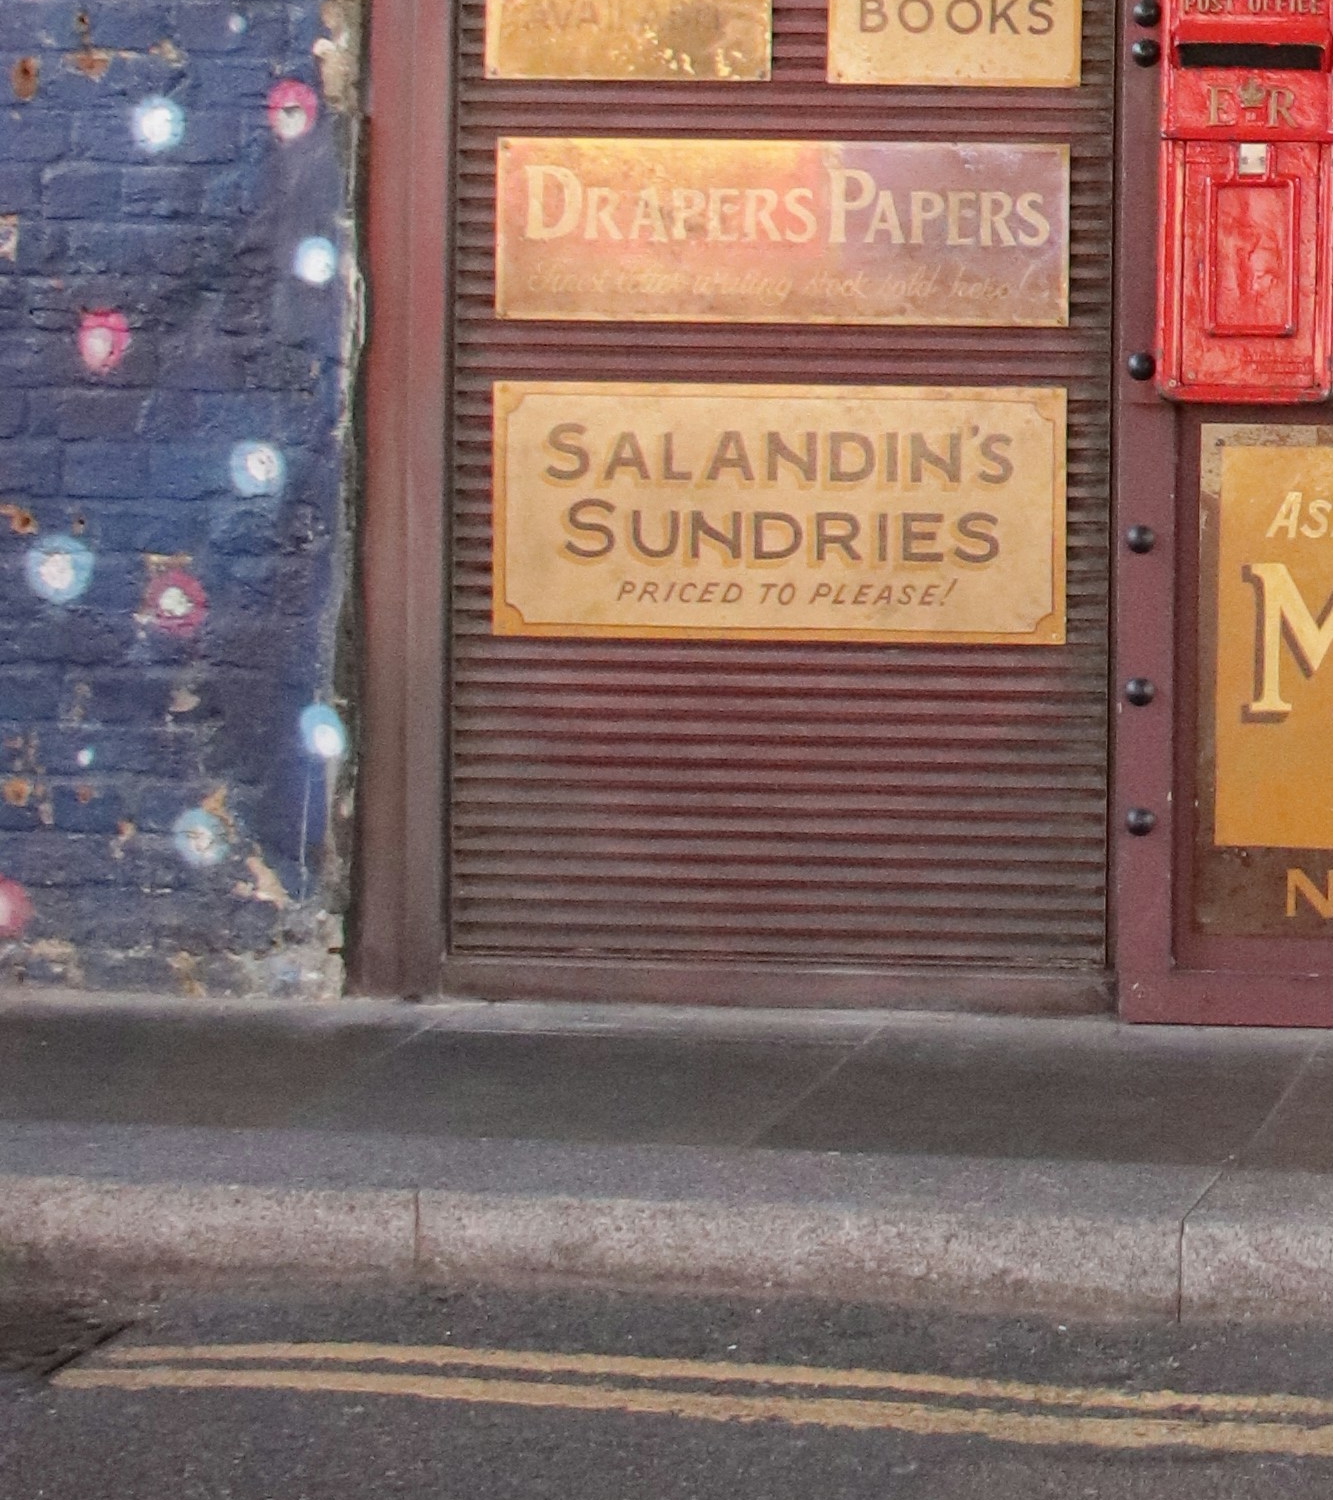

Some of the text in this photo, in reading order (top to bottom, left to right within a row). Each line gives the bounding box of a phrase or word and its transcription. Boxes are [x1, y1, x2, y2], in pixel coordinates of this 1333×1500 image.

[826, 169, 1051, 247] PAPERS
[545, 423, 1014, 489] SALANDIN'S
[564, 498, 999, 568] SUNDRIES
[617, 578, 958, 607] PRICED TO PLEASE!
